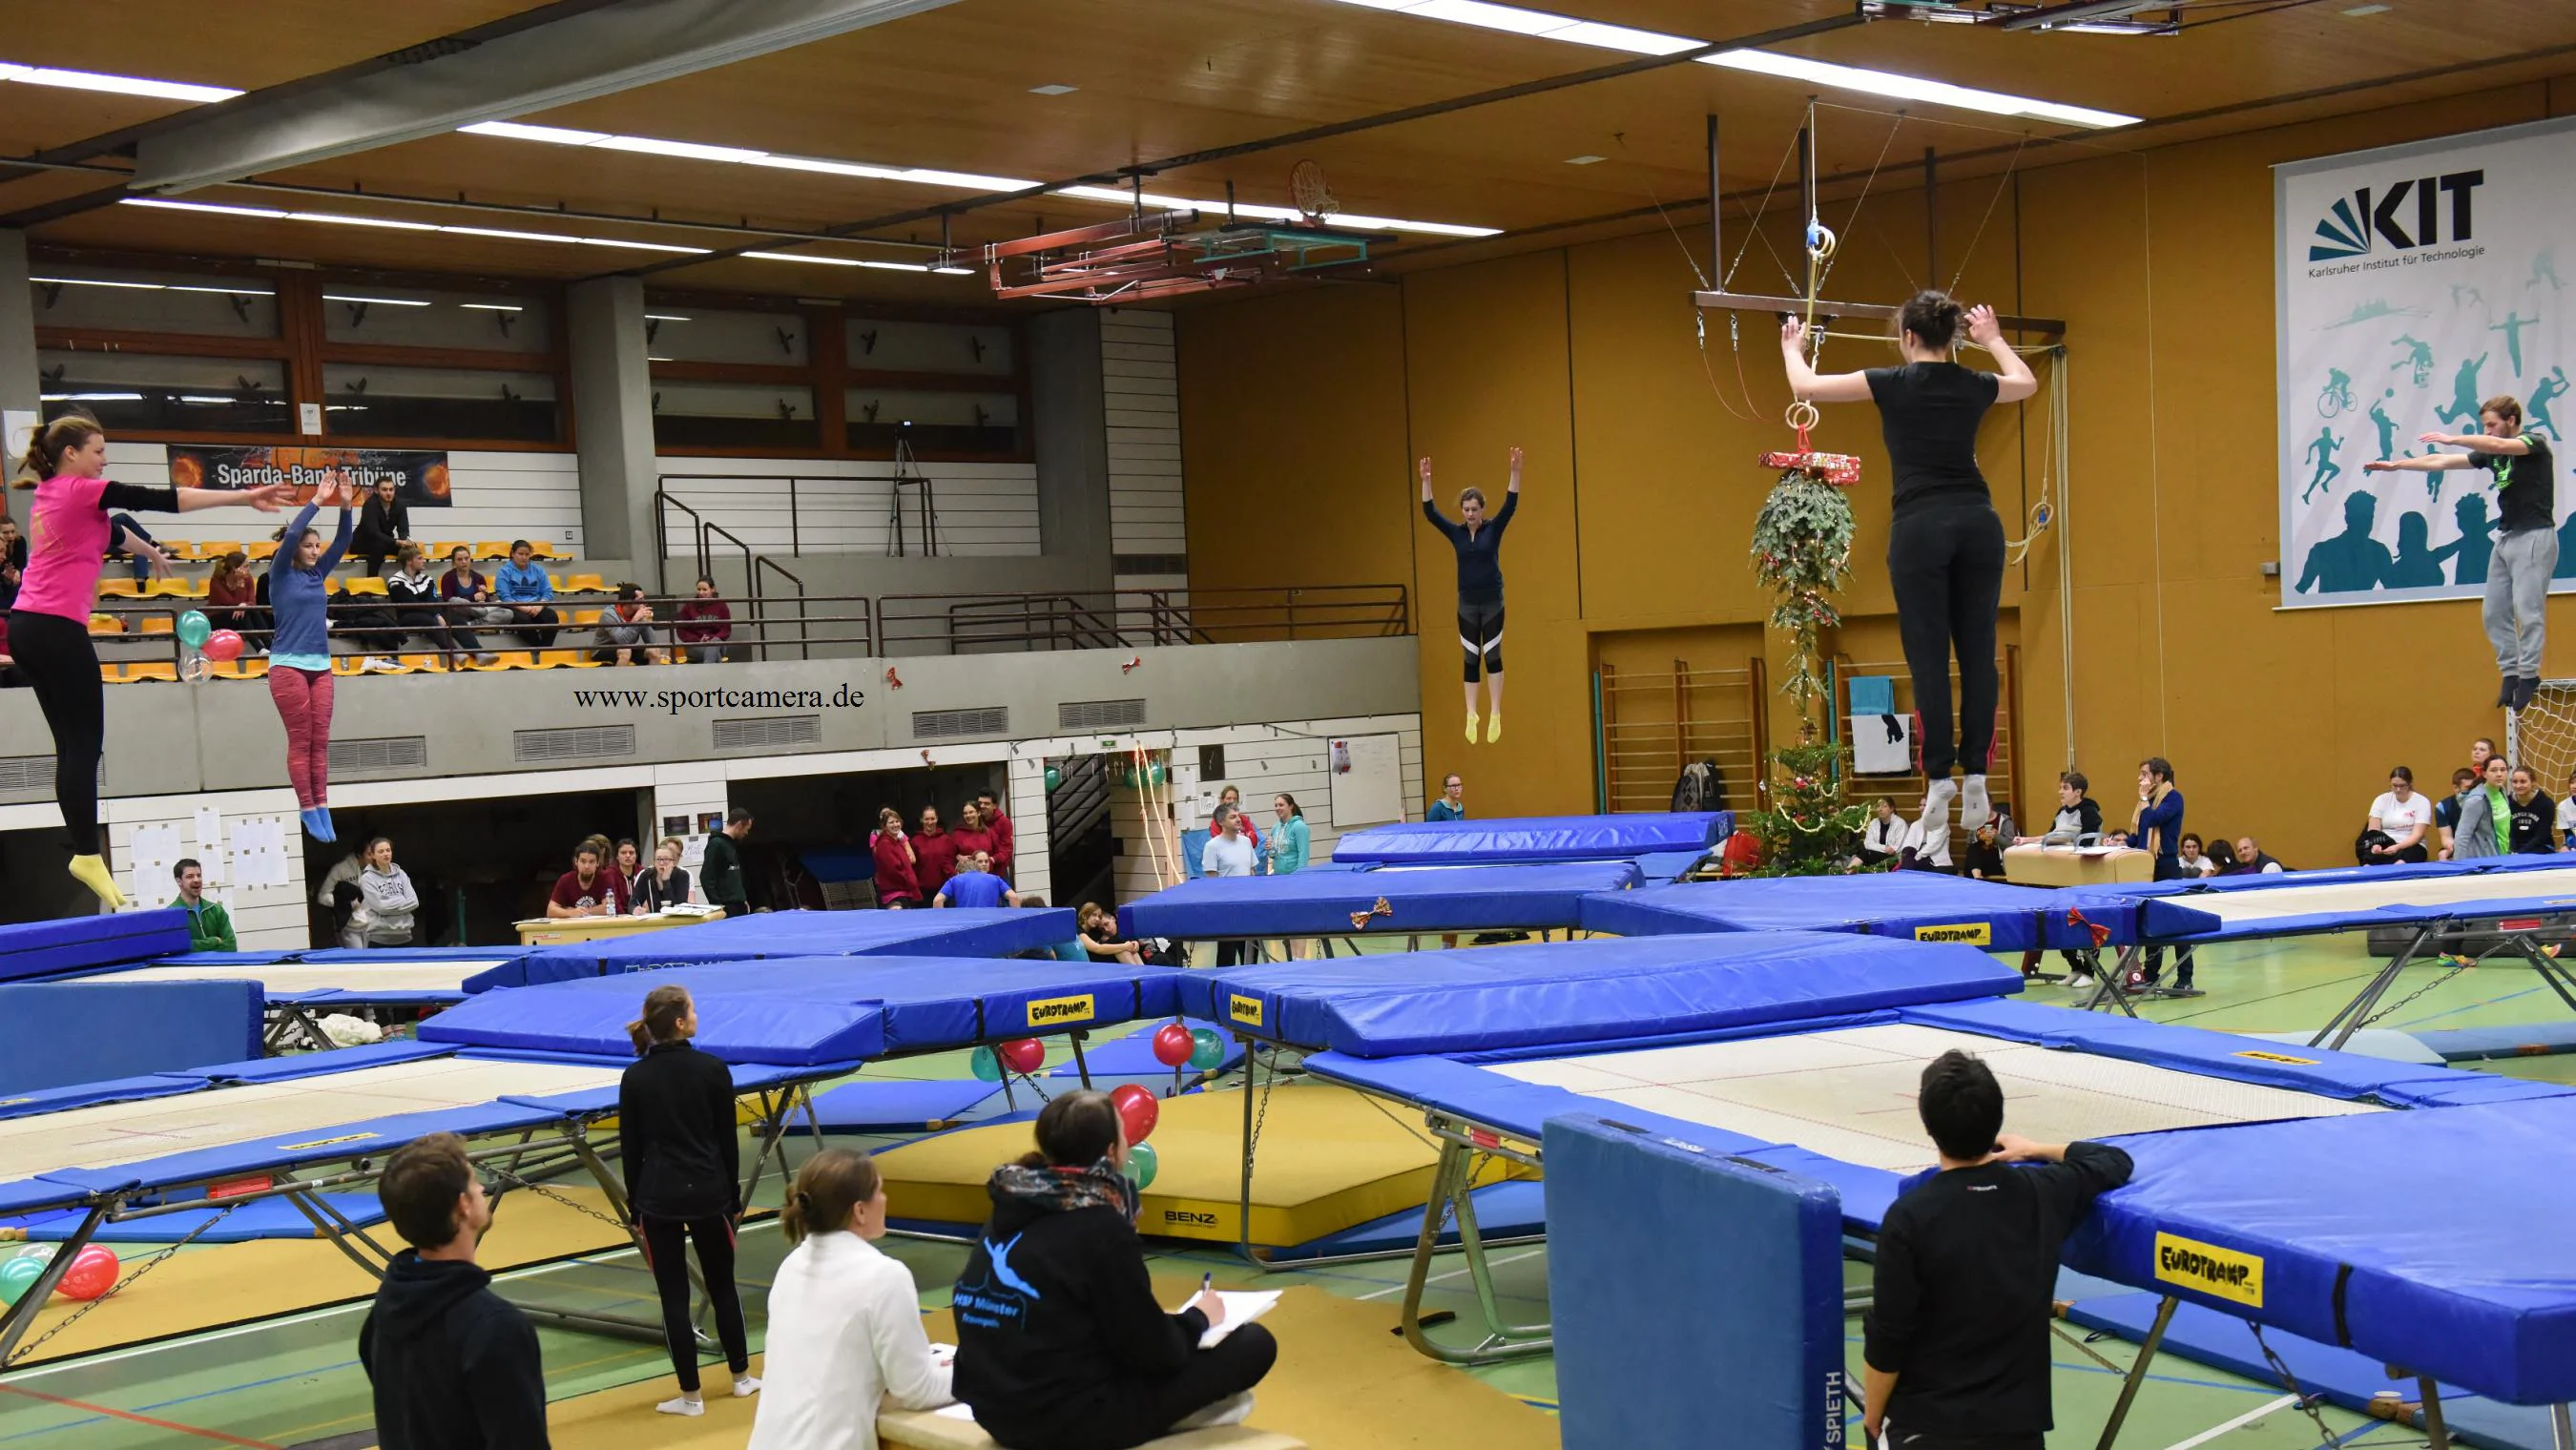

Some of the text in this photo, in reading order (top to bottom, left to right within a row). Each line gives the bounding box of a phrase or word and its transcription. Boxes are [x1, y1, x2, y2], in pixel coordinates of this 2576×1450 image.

[2356, 169, 2484, 249] KIT
[2308, 245, 2485, 279] Karlsruher Institut für Technologie
[1920, 928, 1983, 942] EUROTRAMP
[1031, 1001, 1087, 1020] EUROTRAMP
[1165, 1211, 1215, 1223] BENZ
[2161, 1246, 2249, 1286] EUROTRAMP
[1825, 1372, 1841, 1443] SPIETH
